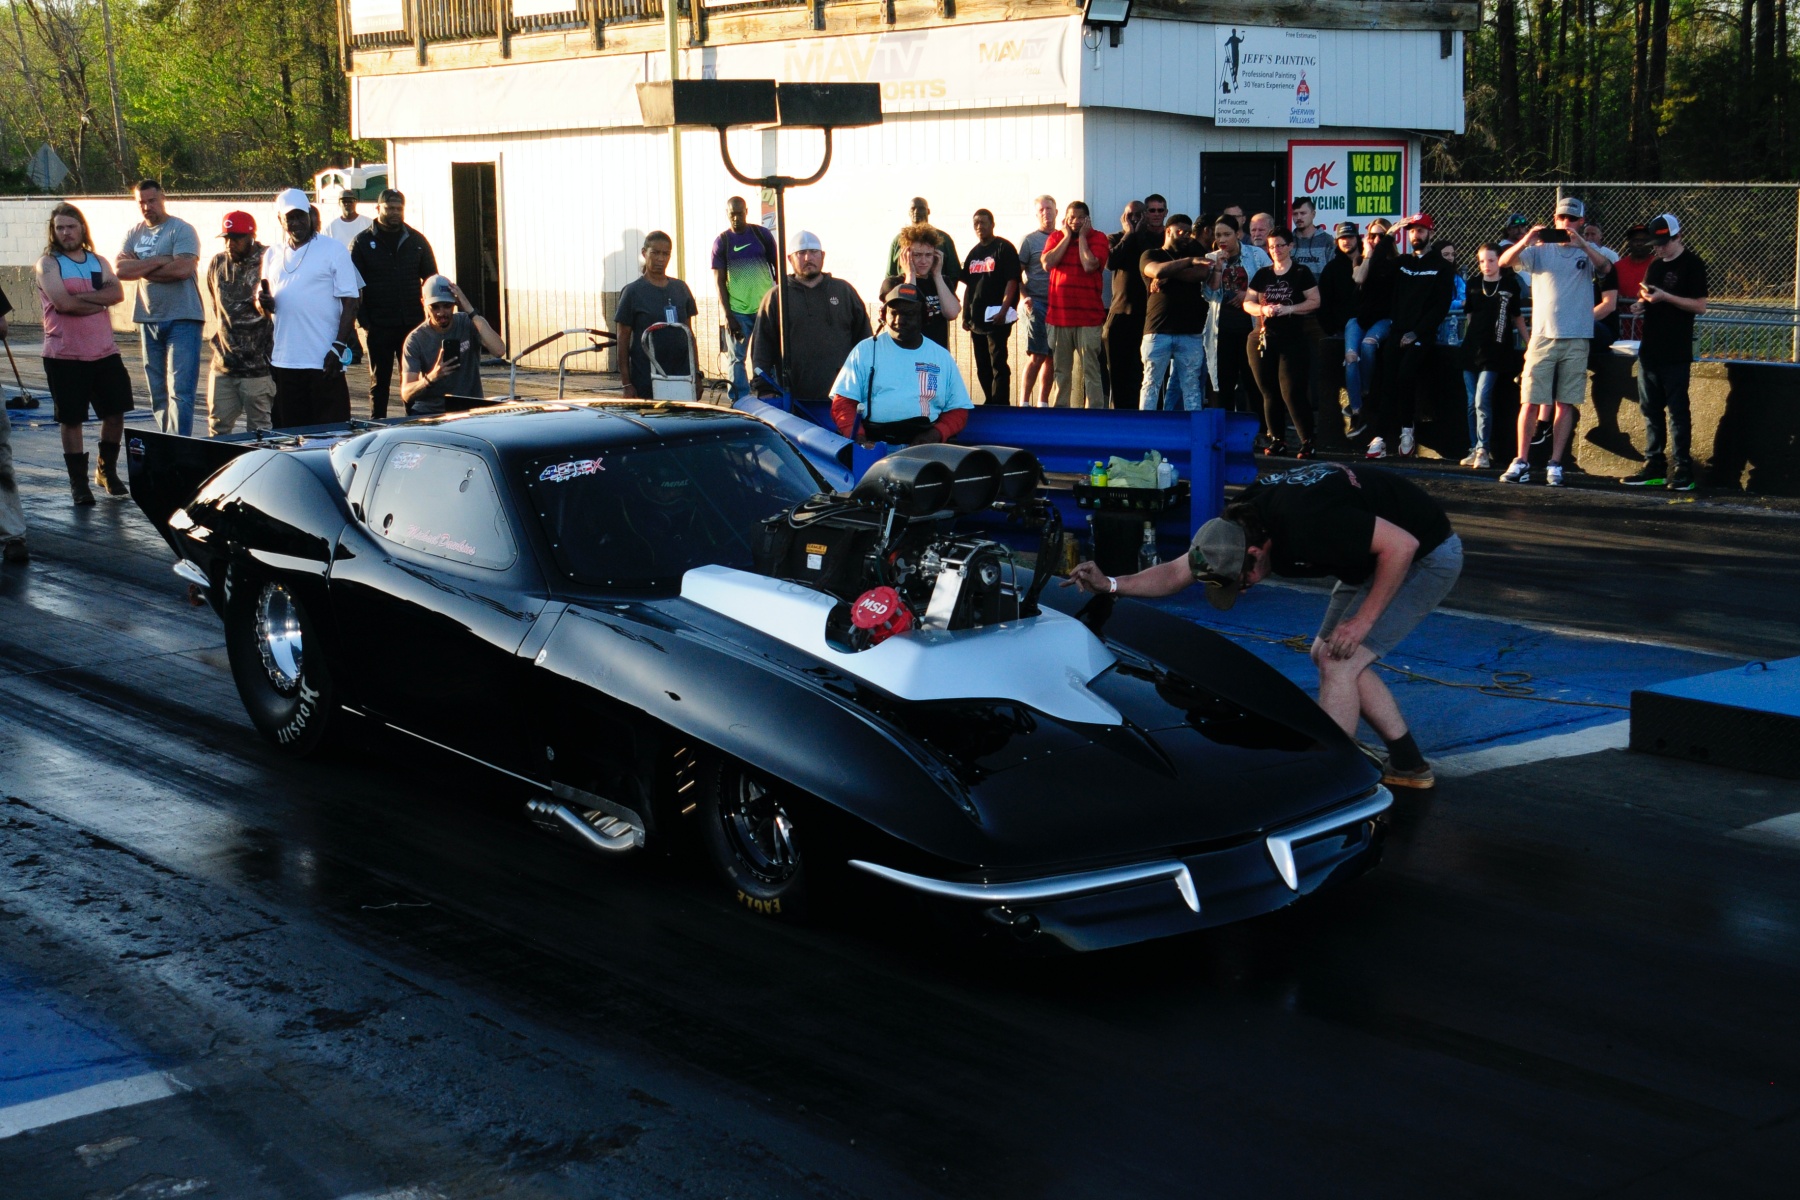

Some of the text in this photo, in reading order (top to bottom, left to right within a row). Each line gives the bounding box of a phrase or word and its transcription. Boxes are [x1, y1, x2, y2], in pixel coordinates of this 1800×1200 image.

[1286, 31, 1317, 40] Free Estimates
[978, 37, 1048, 64] MAVTV
[1242, 53, 1316, 66] JEFF'S PAINTING
[1242, 70, 1296, 81] Professional Painting
[1266, 82, 1294, 91] Experience
[1290, 107, 1315, 116] SHERWIN
[1352, 154, 1397, 172] WE BUY
[1304, 160, 1338, 194] OK
[1355, 175, 1394, 193] SCRAP
[1356, 196, 1392, 214] METAL
[224, 220, 233, 229] C
[140, 234, 160, 246] NIKE
[860, 597, 888, 616] MSD
[737, 889, 782, 915] EAGLE
